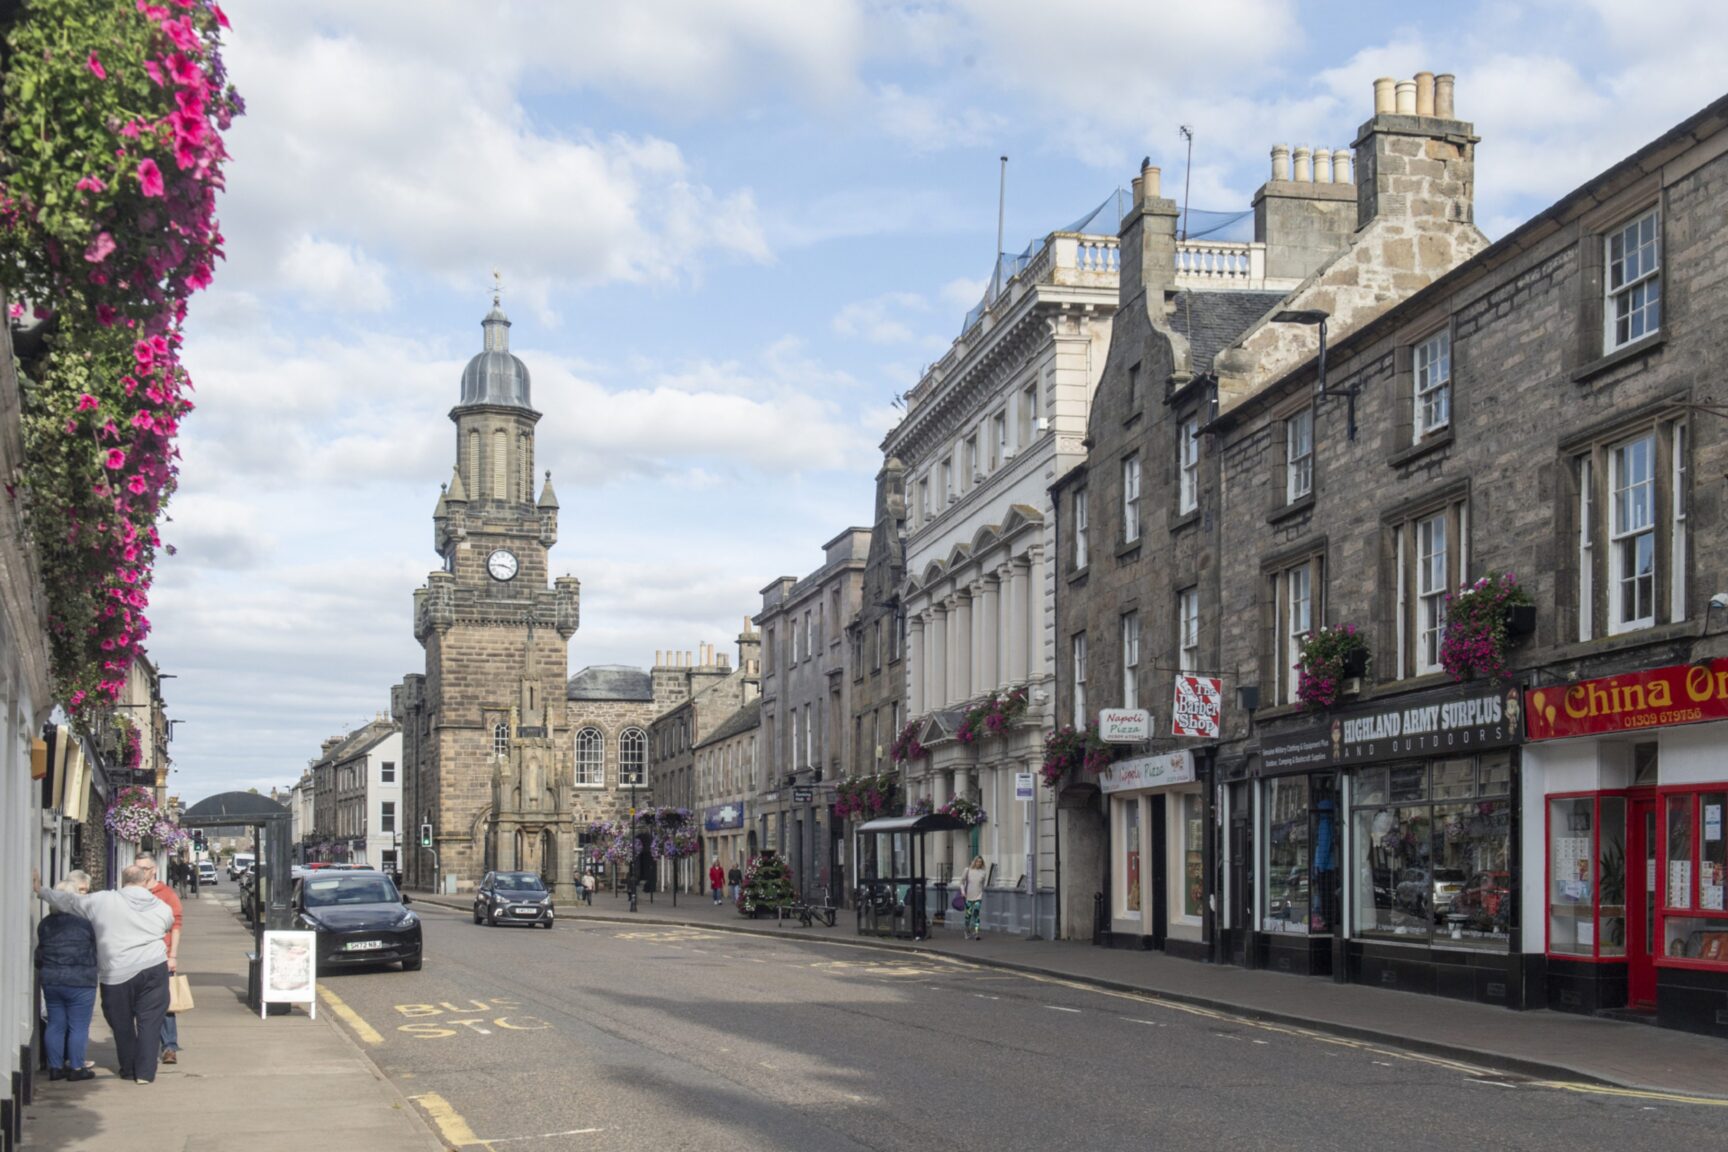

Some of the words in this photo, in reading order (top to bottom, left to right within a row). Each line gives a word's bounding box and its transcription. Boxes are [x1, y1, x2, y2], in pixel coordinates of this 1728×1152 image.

[1195, 684, 1217, 696] The
[1564, 681, 1672, 719] China
[1177, 694, 1218, 716] Barber
[1106, 713, 1144, 724] Napoli
[1179, 714, 1215, 734] Shop
[1344, 712, 1400, 743] HIGHLAND
[1402, 705, 1440, 735] ARMY
[1441, 695, 1502, 729] SURPLUS
[1624, 716, 1657, 728] 01309
[1660, 708, 1702, 724] 679756
[1110, 724, 1142, 733] Pizza
[1344, 743, 1375, 758] AND
[1392, 727, 1502, 752] OUTDOORS
